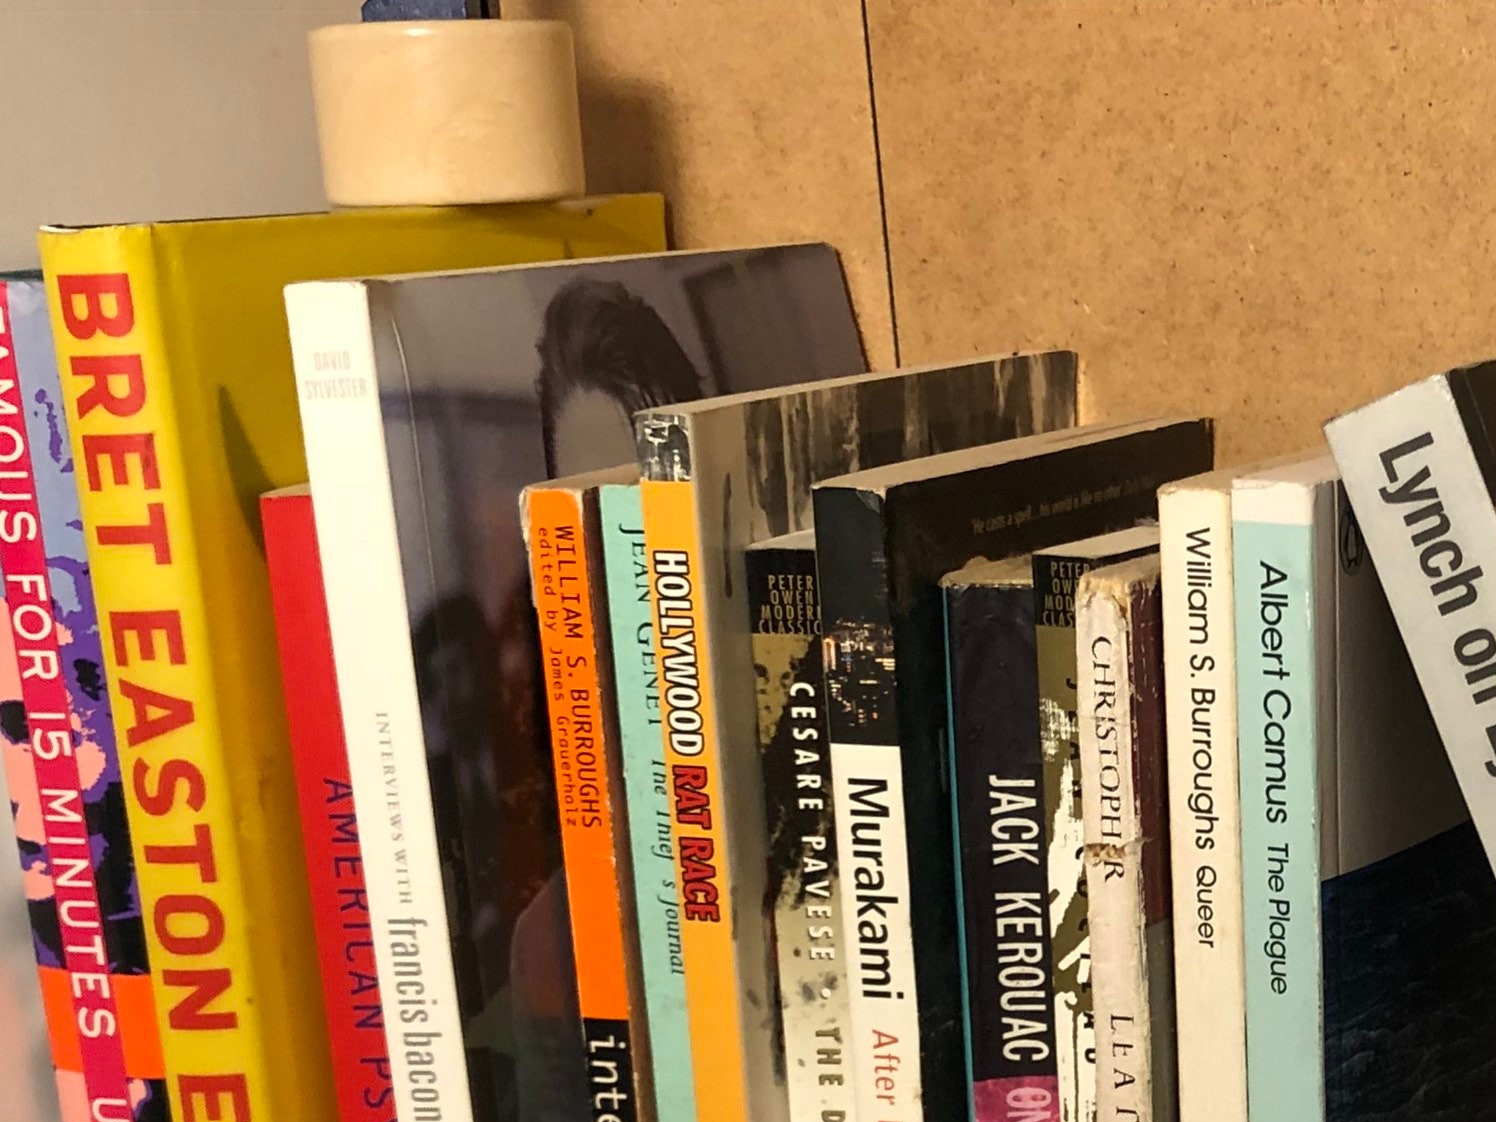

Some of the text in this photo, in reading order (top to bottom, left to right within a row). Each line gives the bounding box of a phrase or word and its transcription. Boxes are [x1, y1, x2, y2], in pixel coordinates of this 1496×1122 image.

[0, 304, 38, 543] MOUS
[56, 272, 172, 565] BRET
[304, 376, 368, 400] SYLVESTER
[313, 350, 351, 371] DAVID
[5, 573, 60, 683] FOR
[758, 619, 823, 635] CLASSIC
[767, 574, 814, 590] PETER
[770, 589, 814, 605] OWEN
[1377, 431, 1485, 618] Lynch
[29, 709, 73, 764] 15
[538, 527, 577, 827] edited by James Grauerholz
[554, 525, 603, 829] WILLIAM S. BURROUGHS
[652, 549, 720, 923] HOLLYWOOD RAT RACE
[789, 682, 824, 811] CESARE
[1091, 635, 1126, 884] CHRISTOPHR
[1185, 526, 1220, 949] William S. Burroughs Queer
[1259, 559, 1293, 995] Albert Camus The Plague
[41, 787, 117, 1039] MINUTES
[107, 609, 238, 1031] EASTON
[373, 711, 443, 1122] INTERVIEWS WITH francis bacon
[801, 835, 836, 961] PAVESE
[846, 777, 905, 1000] Murakami
[988, 774, 1050, 1062] JACK KEROUAC
[815, 1026, 844, 1086] THE
[871, 1028, 901, 1106] After
